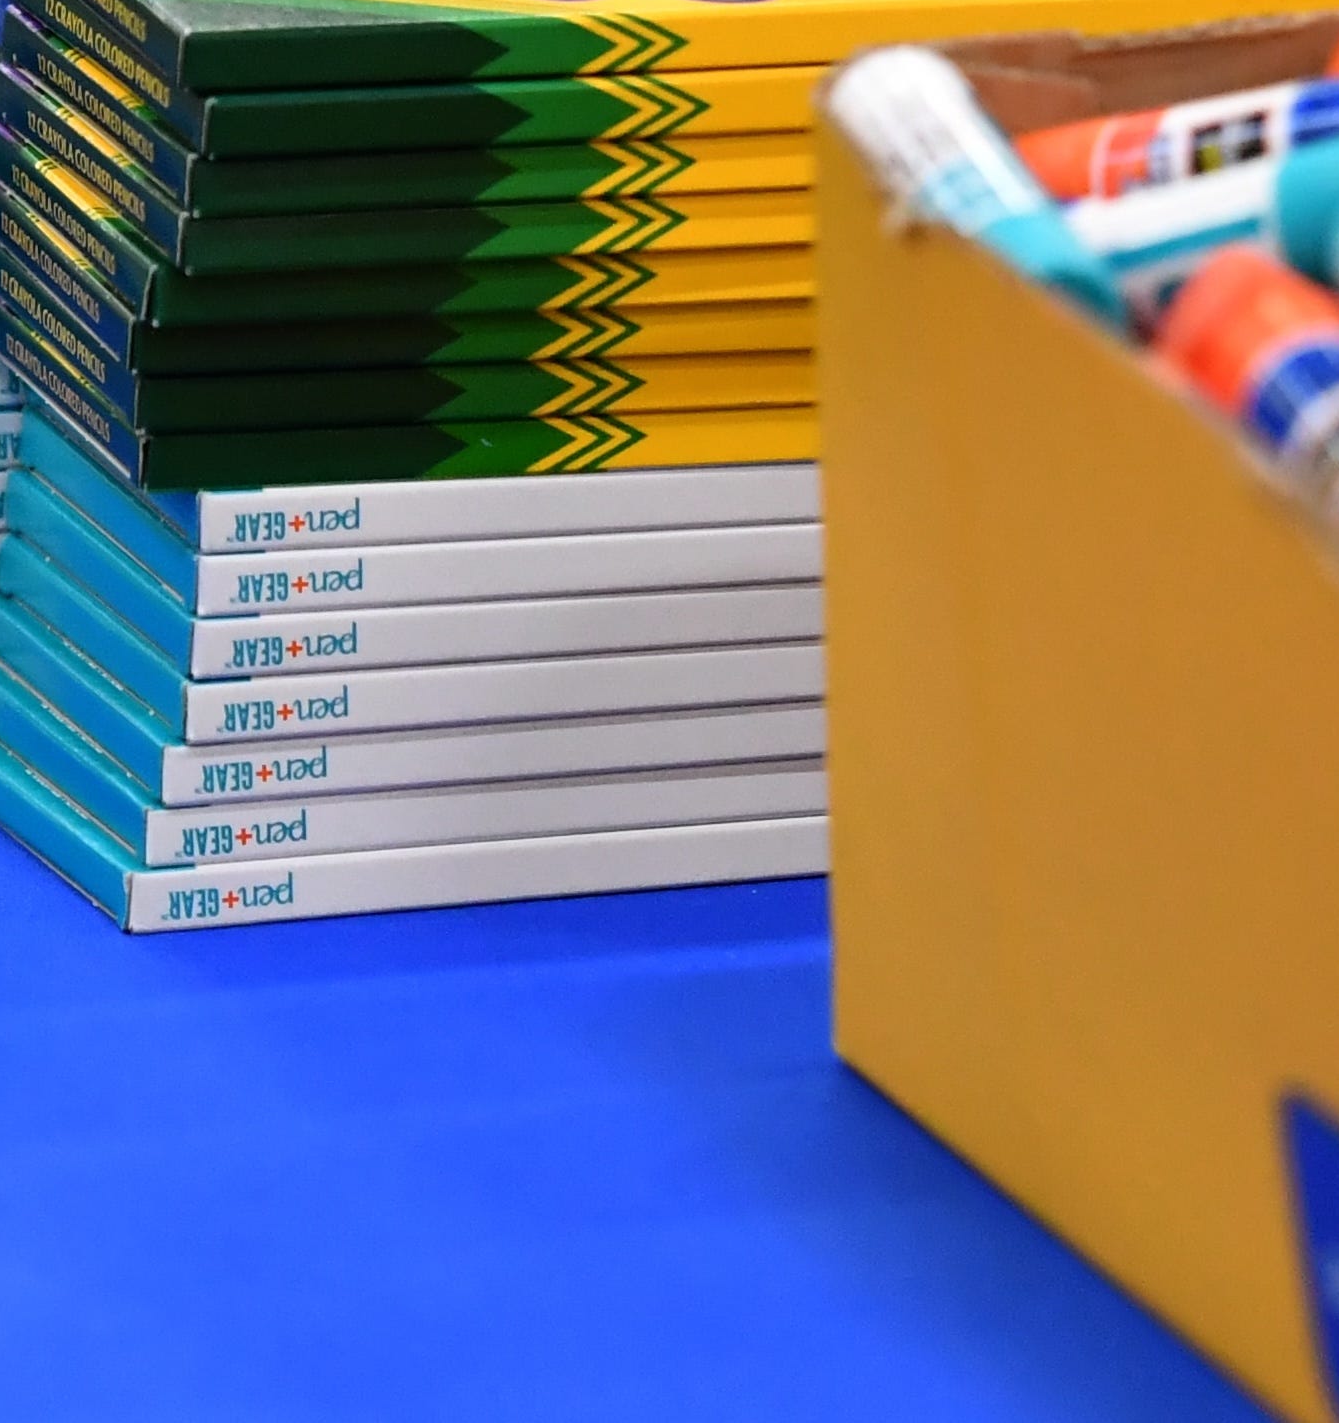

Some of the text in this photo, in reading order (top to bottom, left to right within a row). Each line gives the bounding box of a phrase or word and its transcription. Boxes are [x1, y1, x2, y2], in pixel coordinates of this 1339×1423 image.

[36, 52, 154, 163] 12 CRAYOLA COLORED PENCILS
[53, 0, 93, 47] CRAYOLA
[93, 30, 133, 79] COLORED
[133, 61, 171, 110] PENCILS
[26, 109, 145, 222] 12 CRAYOLA COLORED PENCILS
[19, 171, 53, 216] CRAYOLA
[52, 202, 86, 246] COLORED
[86, 233, 116, 275] PENCILS
[7, 276, 43, 324] CRAYOLA
[41, 307, 76, 355] COLORED
[75, 339, 106, 384] PENCILS
